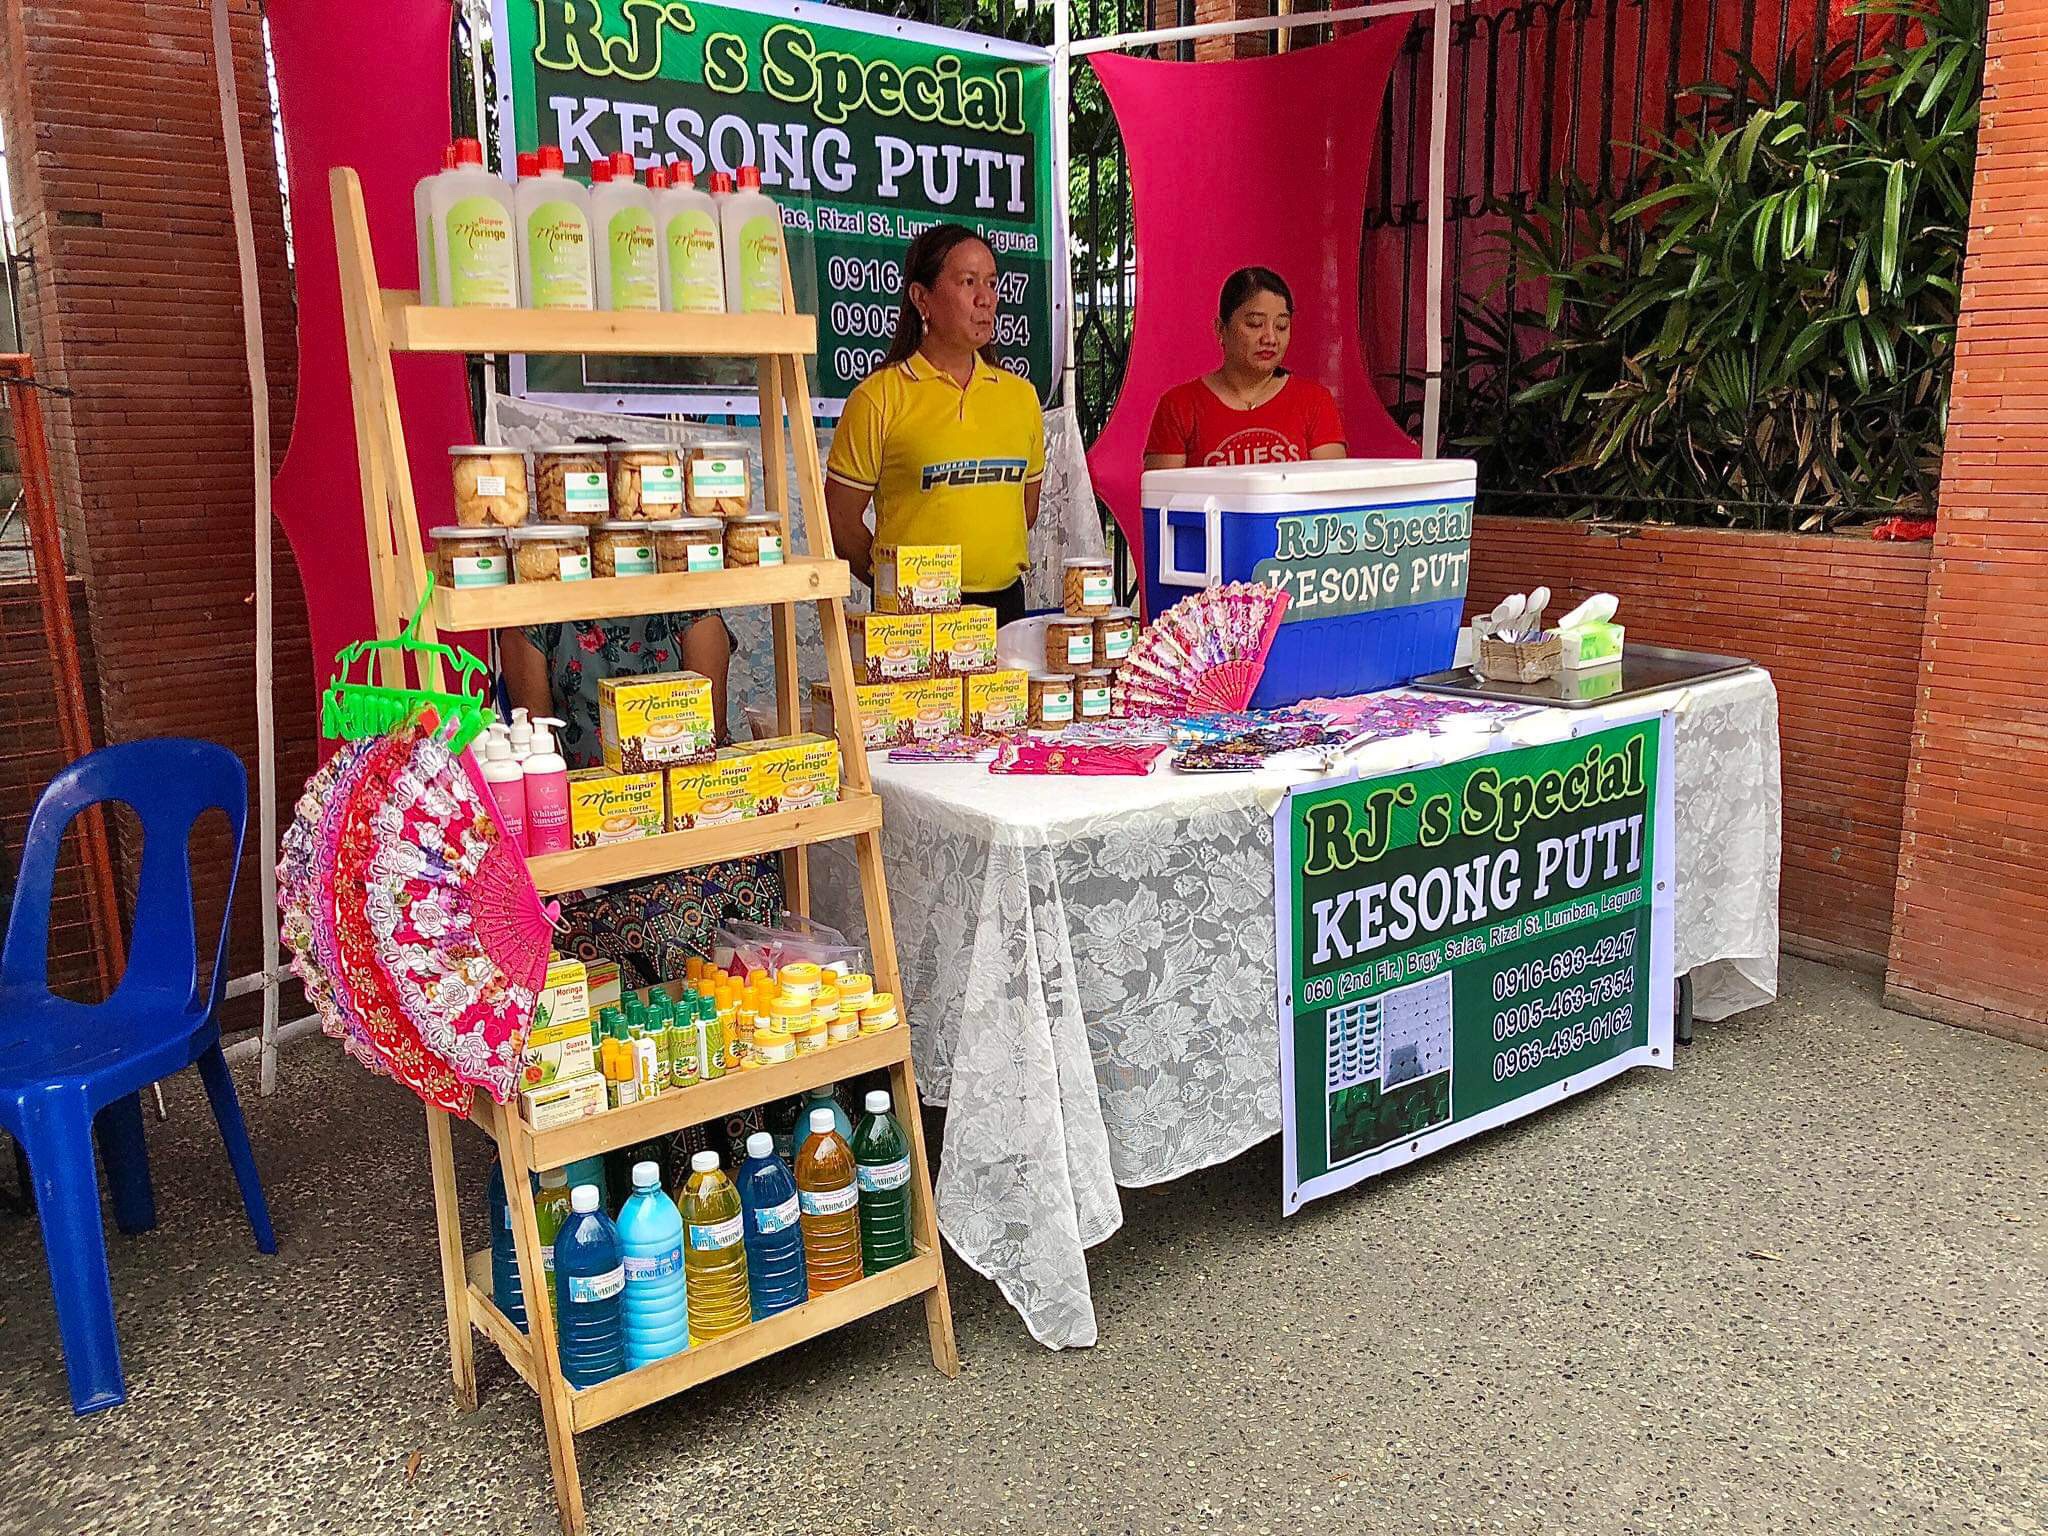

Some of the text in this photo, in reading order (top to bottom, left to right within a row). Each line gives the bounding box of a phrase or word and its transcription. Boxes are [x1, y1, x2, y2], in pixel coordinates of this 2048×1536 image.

[763, 24, 1025, 134] Special
[549, 96, 1025, 212] KESONG PUTI
[777, 203, 814, 232] lac,
[817, 207, 864, 234] Rizal
[868, 215, 893, 237] St.
[453, 221, 506, 250] Moringa
[536, 225, 583, 253] Moringa
[1275, 502, 1473, 561] RJ's Special
[902, 554, 953, 577] Moringa
[1268, 549, 1470, 609] KESONG PUT
[870, 624, 923, 646] Moringa
[937, 619, 989, 641] Moringa
[856, 694, 891, 707] oringa
[903, 687, 954, 708] Moringa
[973, 681, 1020, 702] Moringa
[622, 694, 698, 721] Moringa
[721, 766, 752, 776] Super
[763, 758, 829, 783] Moringa
[625, 781, 657, 791] Super
[677, 773, 748, 800] Moringa
[1461, 733, 1646, 842] Special
[577, 788, 652, 817] Moringa
[1312, 814, 1643, 965] KESONG PUTI
[1303, 977, 1333, 1004] 060
[1338, 964, 1373, 1000] (2nd
[1376, 957, 1404, 985] Flr.)
[1408, 949, 1442, 974] Brgy.
[1445, 936, 1486, 961] Salac,
[1490, 917, 1522, 947] Rizal
[1524, 914, 1543, 936] St.
[1545, 903, 1599, 930] Lumban,
[1493, 928, 1637, 1001] 0916-693-4247
[556, 985, 583, 997] Moringa
[1493, 966, 1634, 1042] 0905-463-7354
[1493, 1004, 1633, 1081] 0963-435-0162
